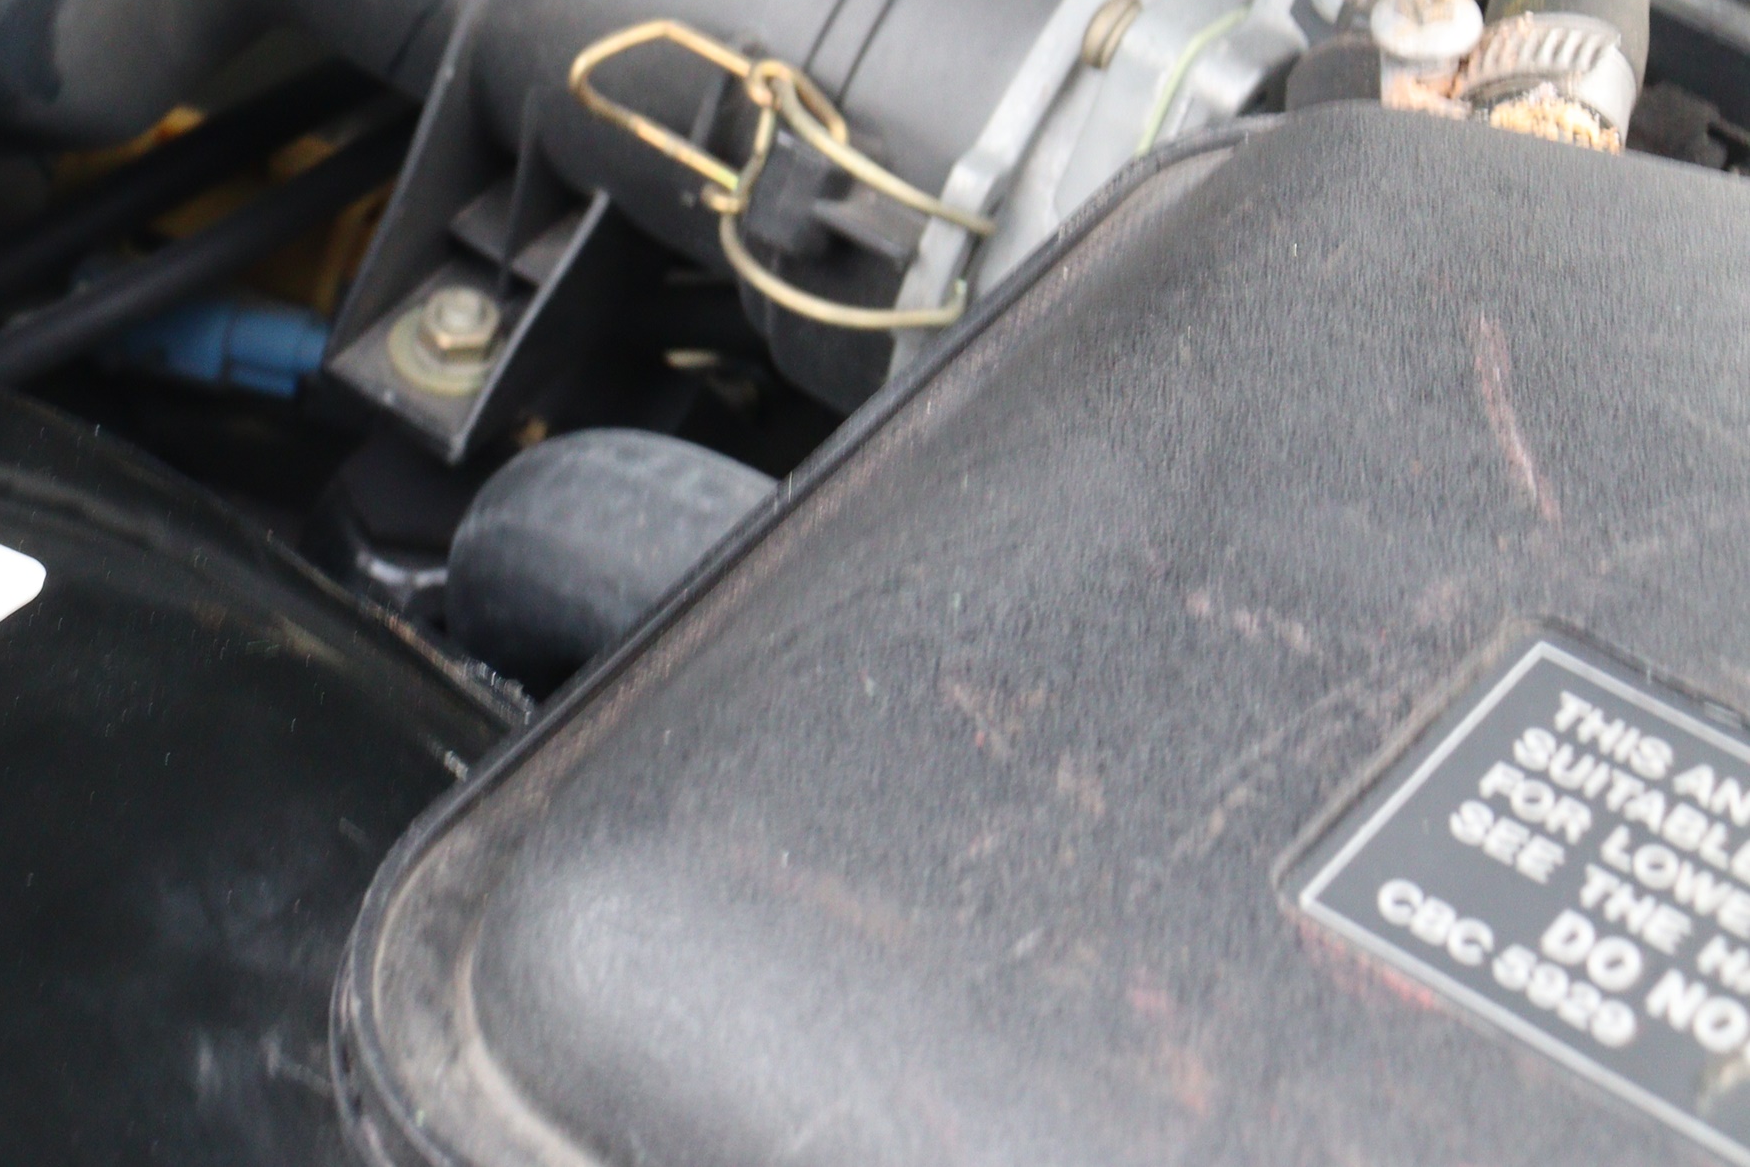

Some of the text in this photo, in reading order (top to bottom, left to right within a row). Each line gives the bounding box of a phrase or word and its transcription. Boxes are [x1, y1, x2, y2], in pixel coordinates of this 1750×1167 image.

[1554, 690, 1673, 780] THIS
[1479, 760, 1592, 845] FOR
[1377, 878, 1494, 966] CBC
[1450, 800, 1566, 884] SEE
[1580, 863, 1692, 955] THE
[1541, 909, 1750, 1066] DO NO
